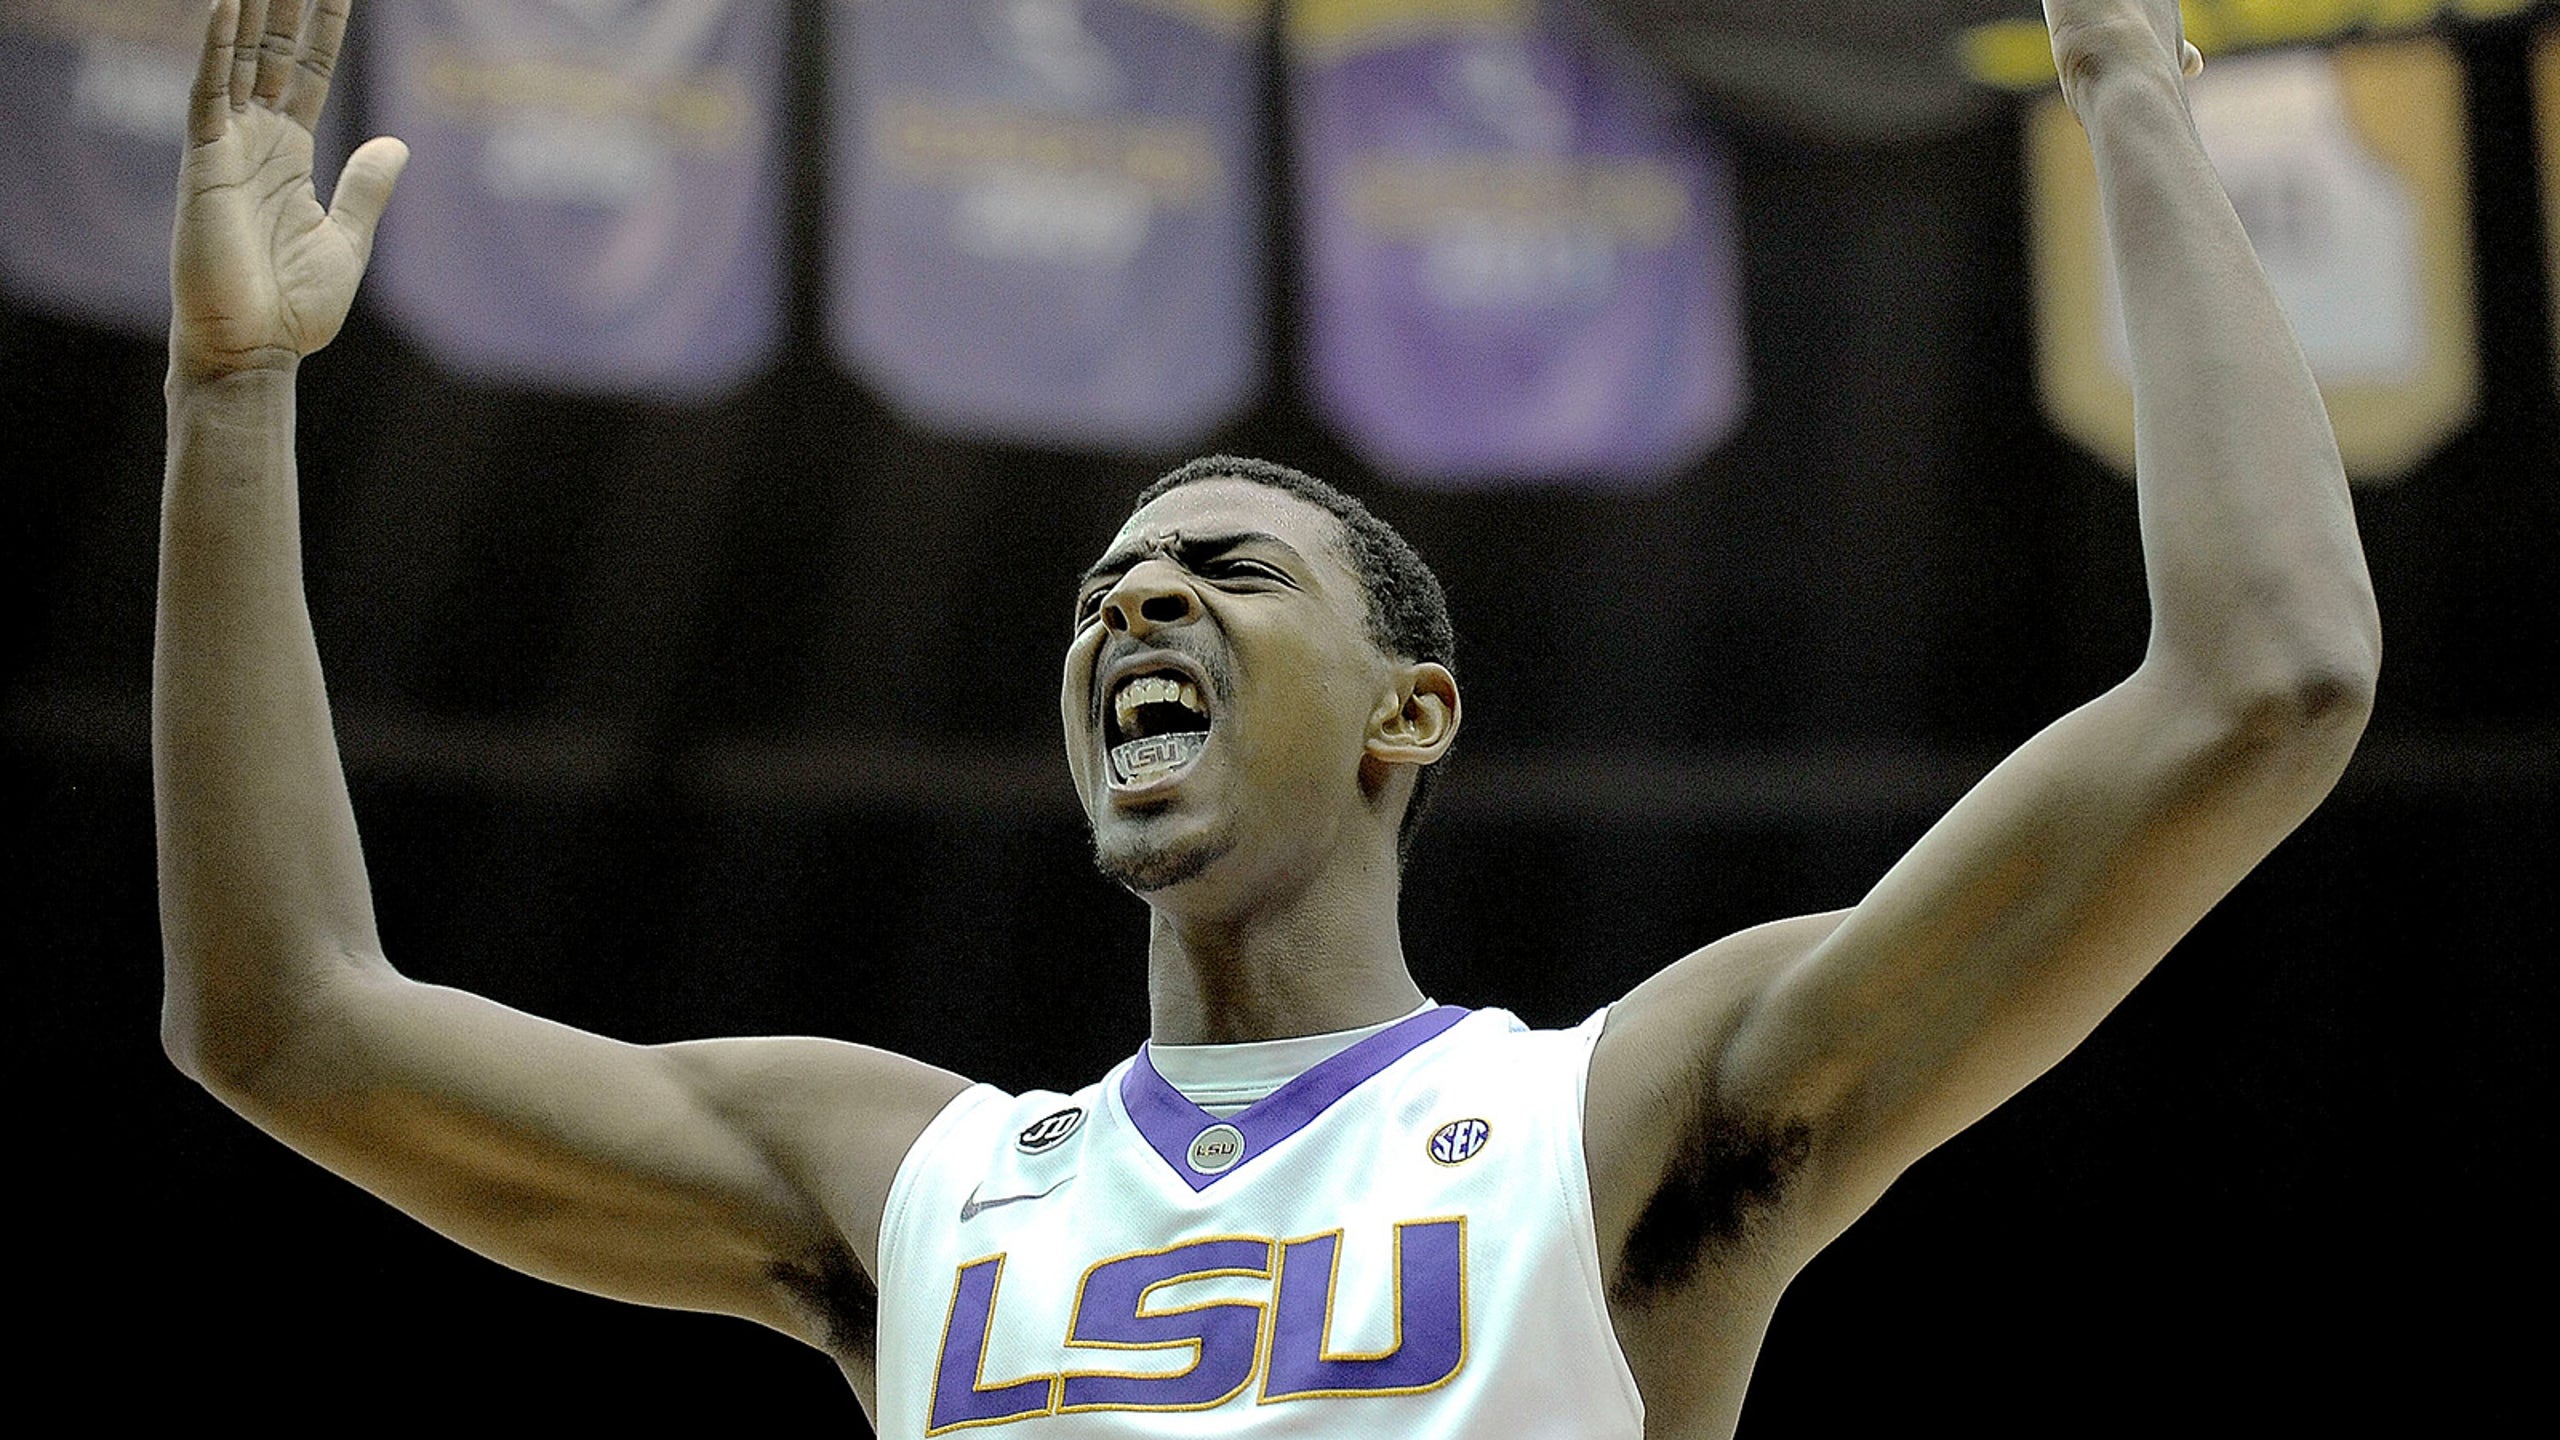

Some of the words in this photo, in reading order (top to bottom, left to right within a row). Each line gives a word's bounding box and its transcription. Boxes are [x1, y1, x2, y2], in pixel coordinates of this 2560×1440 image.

[1124, 742, 1178, 771] LSU
[1196, 1143, 1235, 1156] LSU
[1432, 1120, 1488, 1161] SEC
[926, 1215, 1468, 1438] LSU
